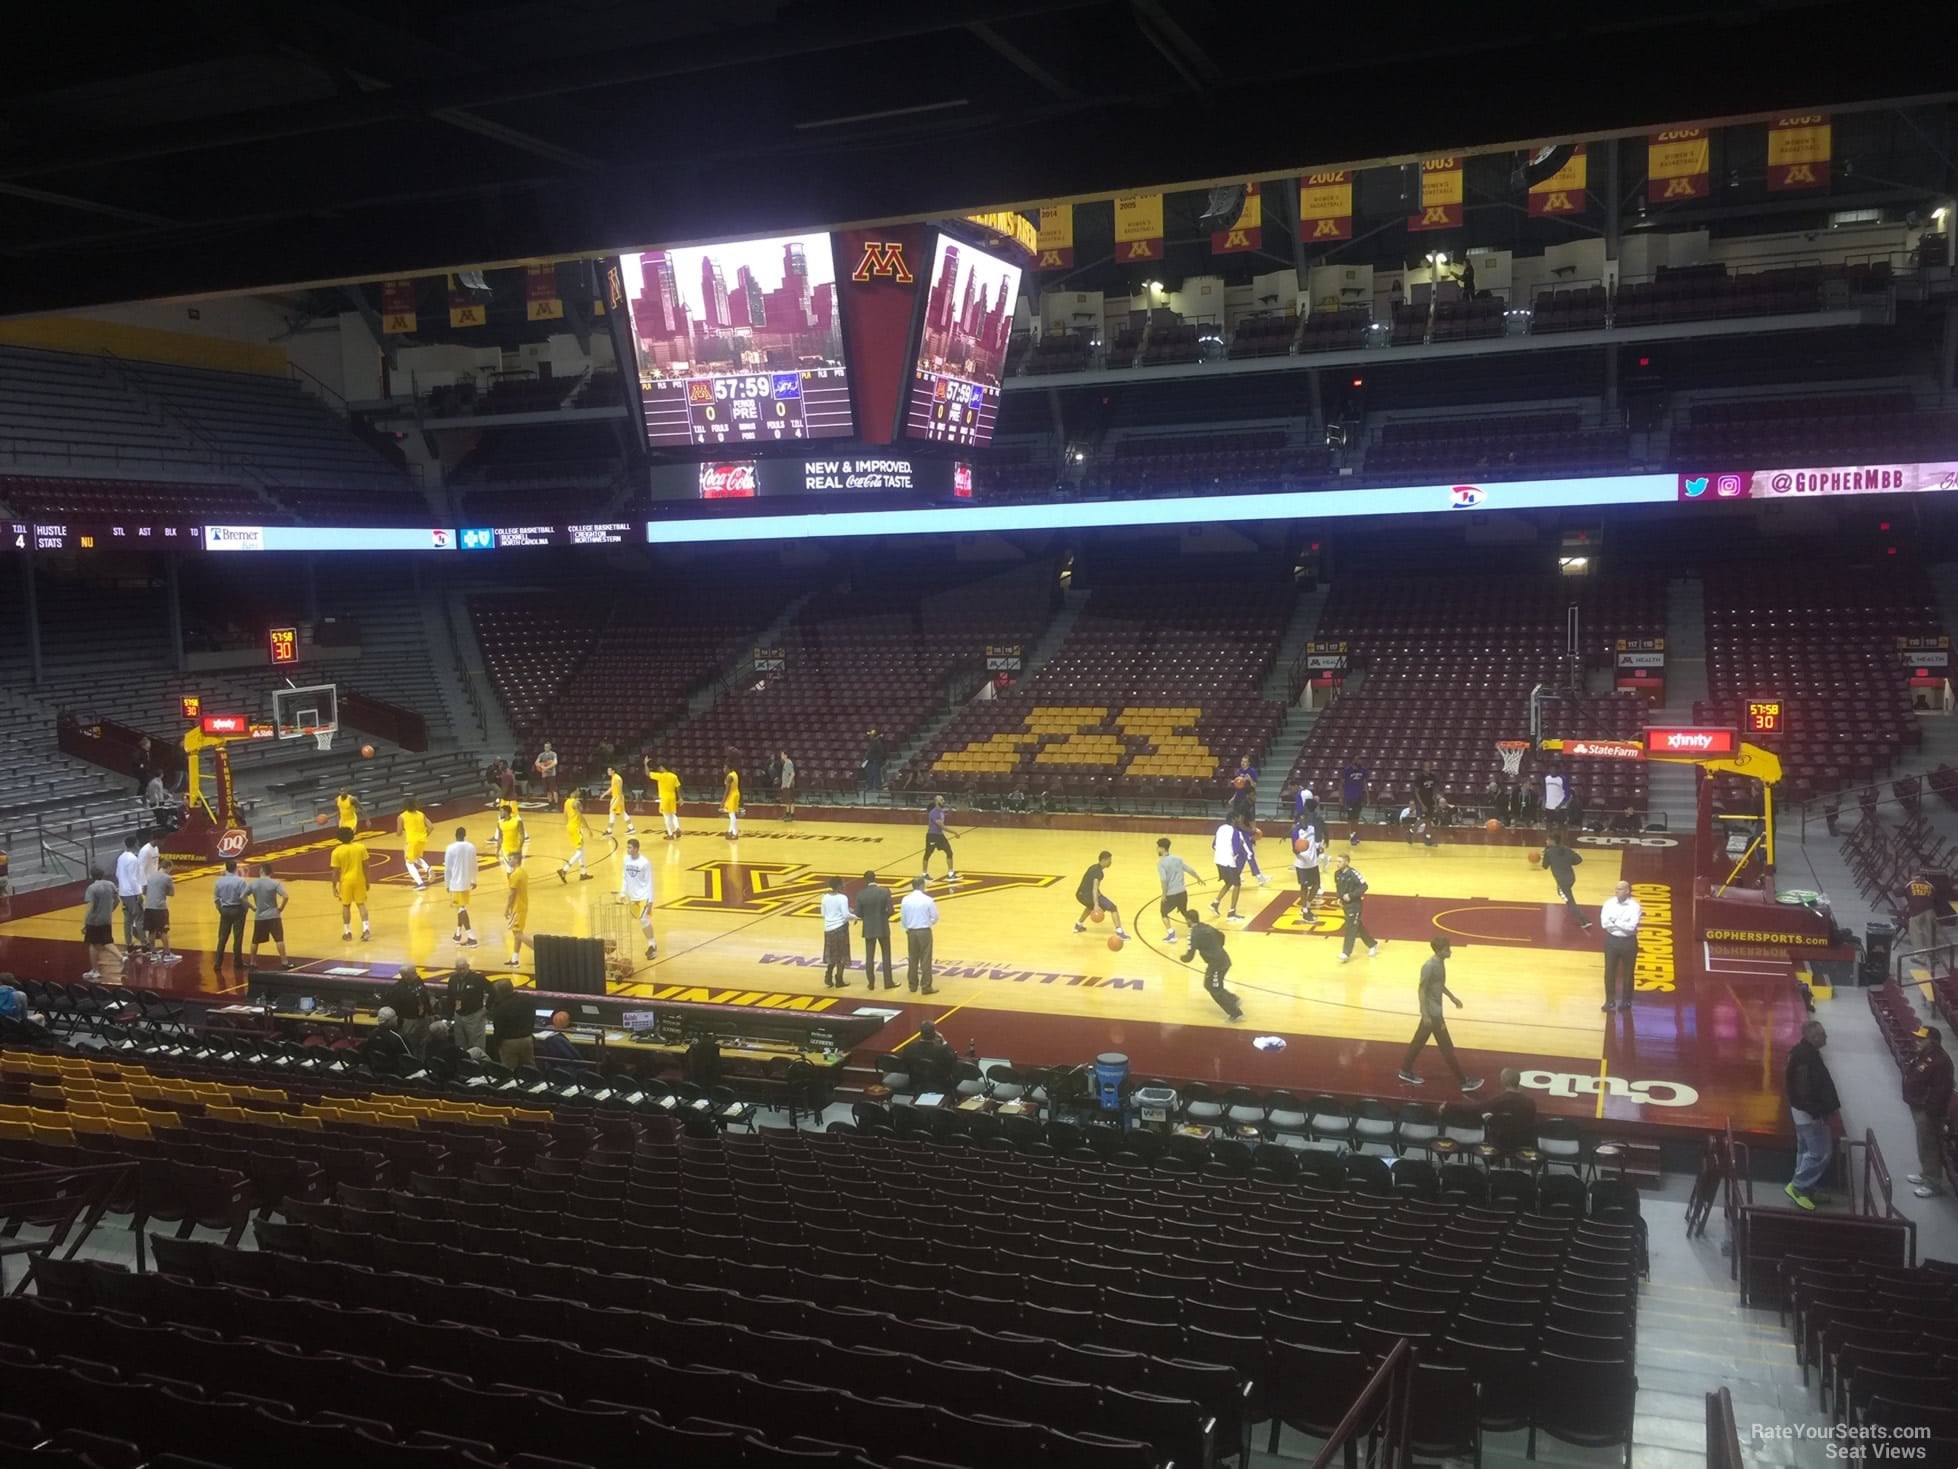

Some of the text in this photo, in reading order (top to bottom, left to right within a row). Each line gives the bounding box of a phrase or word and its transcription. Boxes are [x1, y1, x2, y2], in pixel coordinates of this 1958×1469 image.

[1313, 219, 1339, 237] M
[852, 241, 913, 283] M
[715, 377, 770, 400] 57:59
[946, 381, 971, 404] 57:59
[706, 402, 786, 421] 0 PRE 0
[805, 461, 912, 474] NEW & IMPROVED.
[806, 476, 843, 490] REAL
[884, 475, 913, 488] TASTE.
[36, 526, 67, 536] HUSTLE
[113, 528, 125, 536] STL
[139, 528, 151, 536] AST
[165, 528, 177, 537] BLK
[223, 528, 259, 541] Bremer
[594, 523, 631, 531] BASKETBALL
[16, 534, 94, 548] 4 STATS NU
[276, 643, 291, 659] 30
[187, 707, 197, 716] 30
[1750, 704, 1779, 715] 57:58
[1756, 716, 1774, 729] 30
[1667, 733, 1712, 750] xfinity
[220, 752, 235, 818] MINNESOTA
[223, 835, 244, 851] DQ
[1577, 836, 1679, 847] Cub
[1706, 929, 1829, 946] GOPHERSPORTS.com
[1634, 926, 1677, 993] GOPHERS
[1519, 1070, 1699, 1107] Cub
